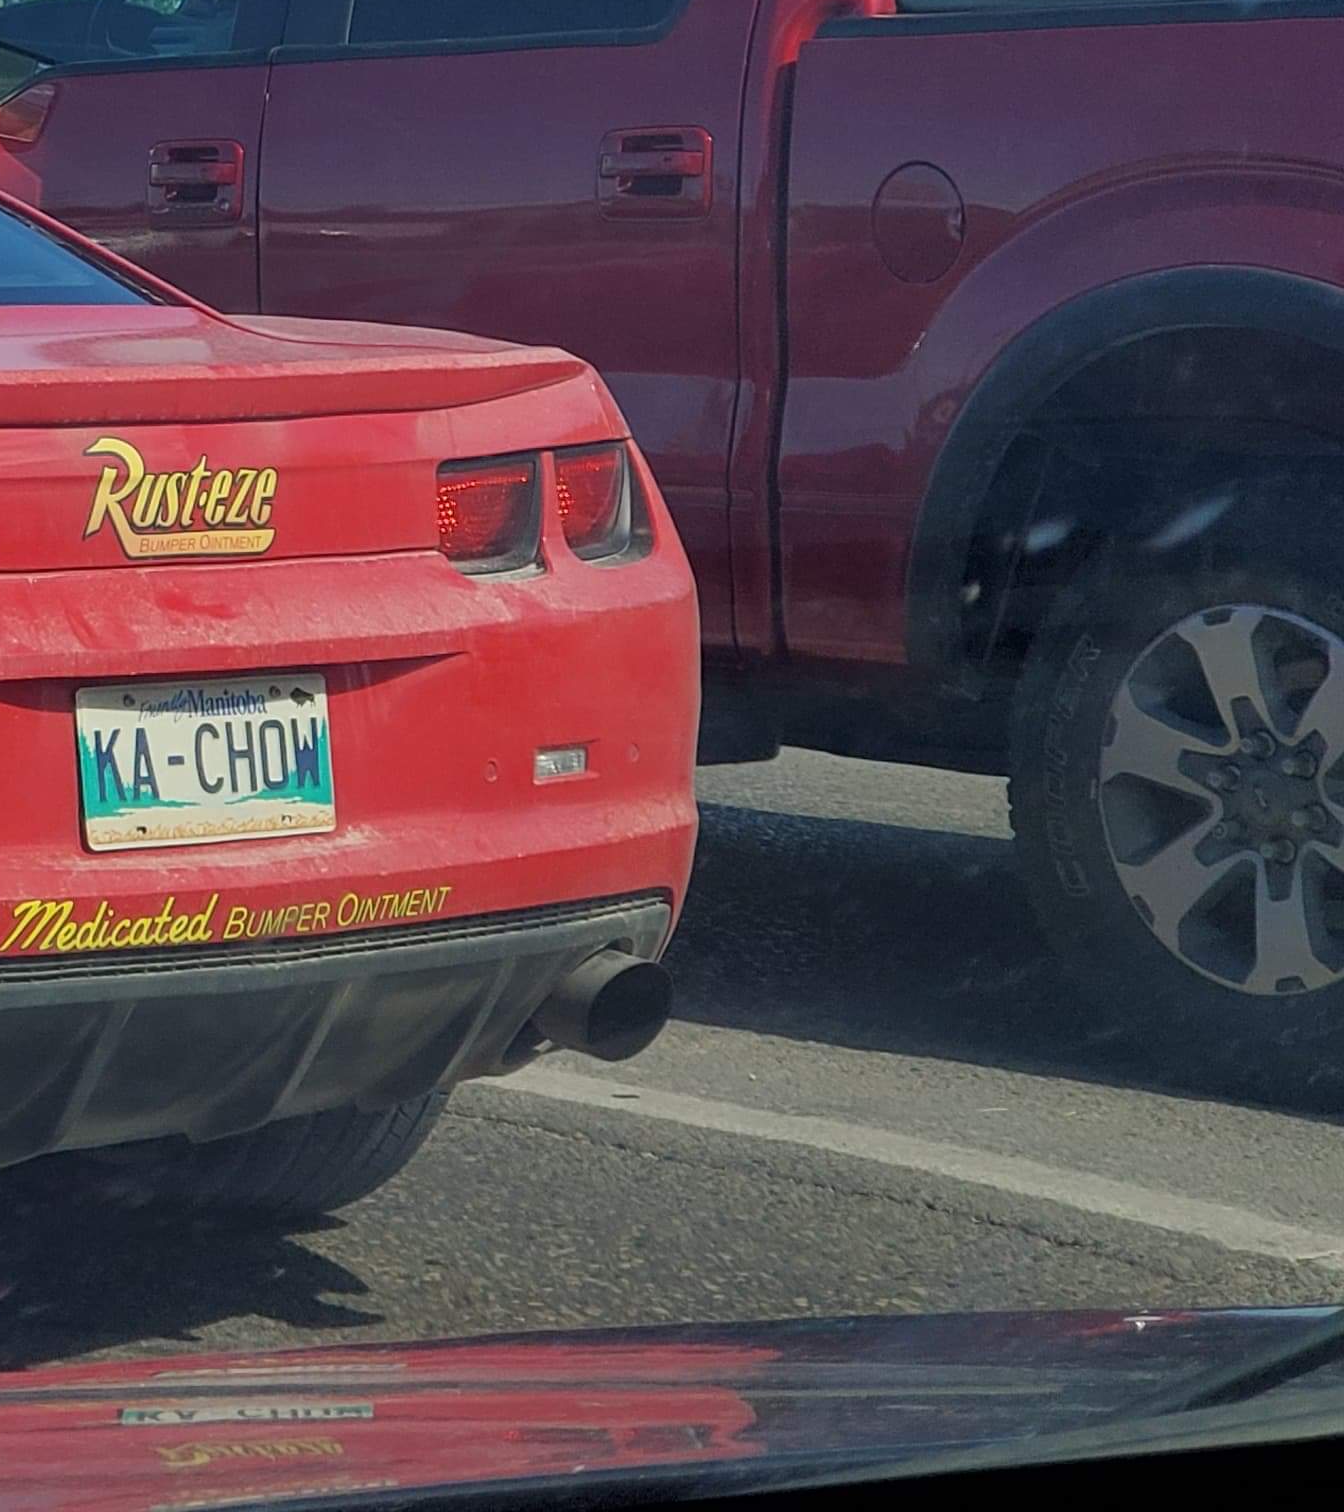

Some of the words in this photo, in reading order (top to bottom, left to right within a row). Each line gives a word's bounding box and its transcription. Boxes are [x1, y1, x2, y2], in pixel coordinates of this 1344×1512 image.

[139, 537, 197, 553] BUMPER
[199, 535, 262, 551] OINTMENT
[187, 689, 268, 718] Manitoba
[94, 717, 321, 803] KA-CHOW
[0, 893, 219, 954] Medicated
[224, 903, 330, 940] BUMPER
[336, 886, 454, 927] OINTMENT
